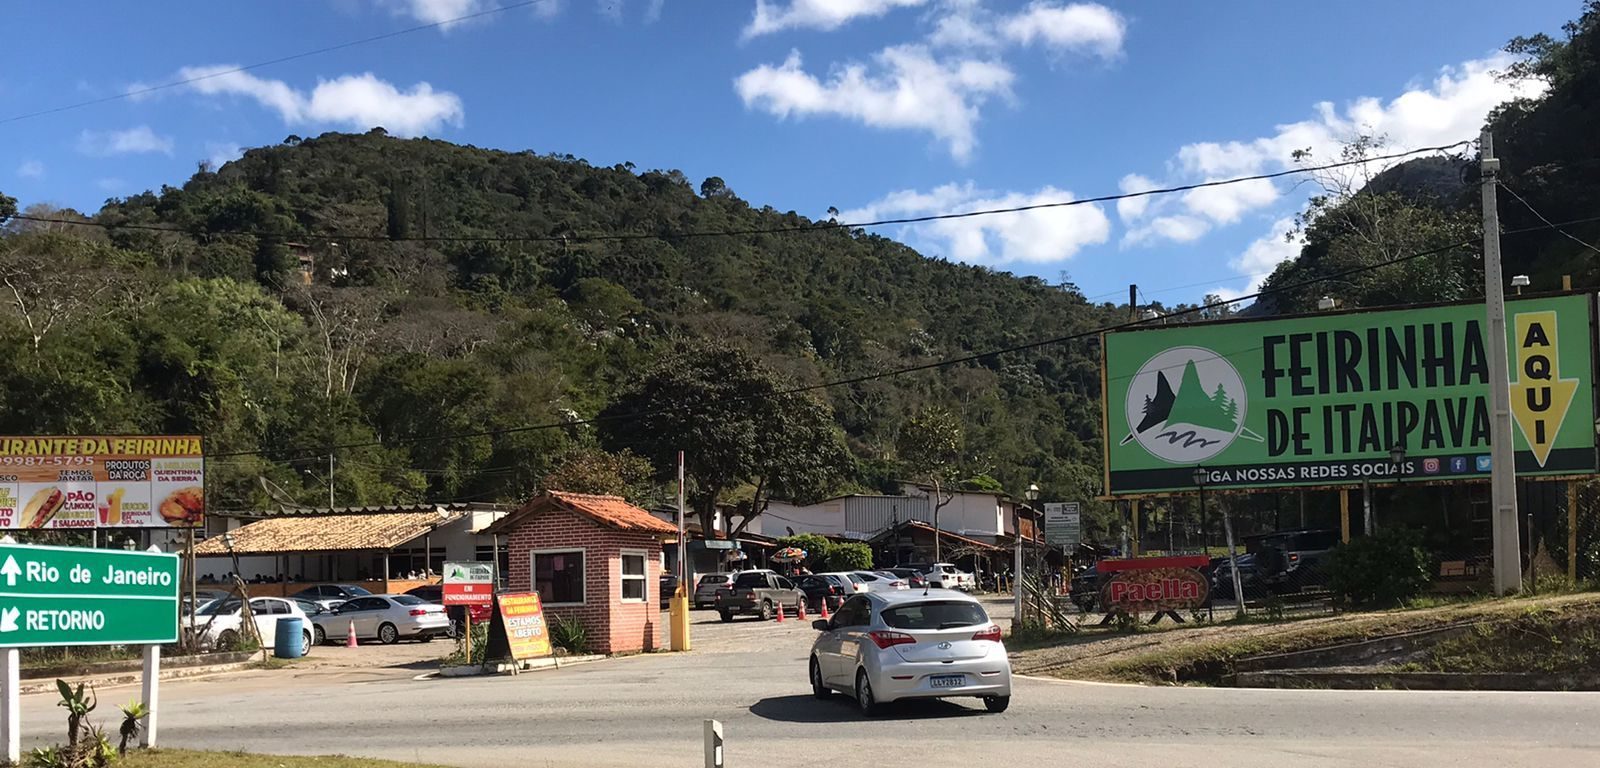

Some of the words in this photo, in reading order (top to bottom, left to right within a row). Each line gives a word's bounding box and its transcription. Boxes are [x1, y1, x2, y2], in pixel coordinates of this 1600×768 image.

[1262, 319, 1489, 398] FEIRINHA
[1523, 322, 1552, 445] AQUI
[1266, 407, 1312, 457] DE
[1323, 396, 1491, 454] ITAIPAVA
[82, 439, 109, 455] DA
[113, 439, 202, 455] FEIRINHA
[105, 460, 150, 470] PRODUTOS
[1194, 469, 1231, 483] IGA
[1236, 467, 1295, 481] NOSSAS
[1300, 464, 1347, 478] REDES
[1352, 461, 1415, 475] SOCIAIS
[109, 470, 122, 480] DA
[123, 470, 146, 482] ROÇA
[67, 491, 95, 502] PÃO
[59, 520, 95, 528] SALGADOS
[26, 561, 60, 583] Rio
[69, 564, 92, 584] de
[102, 564, 172, 587] Janeiro
[445, 593, 492, 601] FUNCIONAMENTO
[1110, 578, 1199, 602] Paella
[26, 610, 106, 631] RETORNO
[508, 616, 542, 627] ESTAMOS
[513, 627, 541, 638] ABERTO
